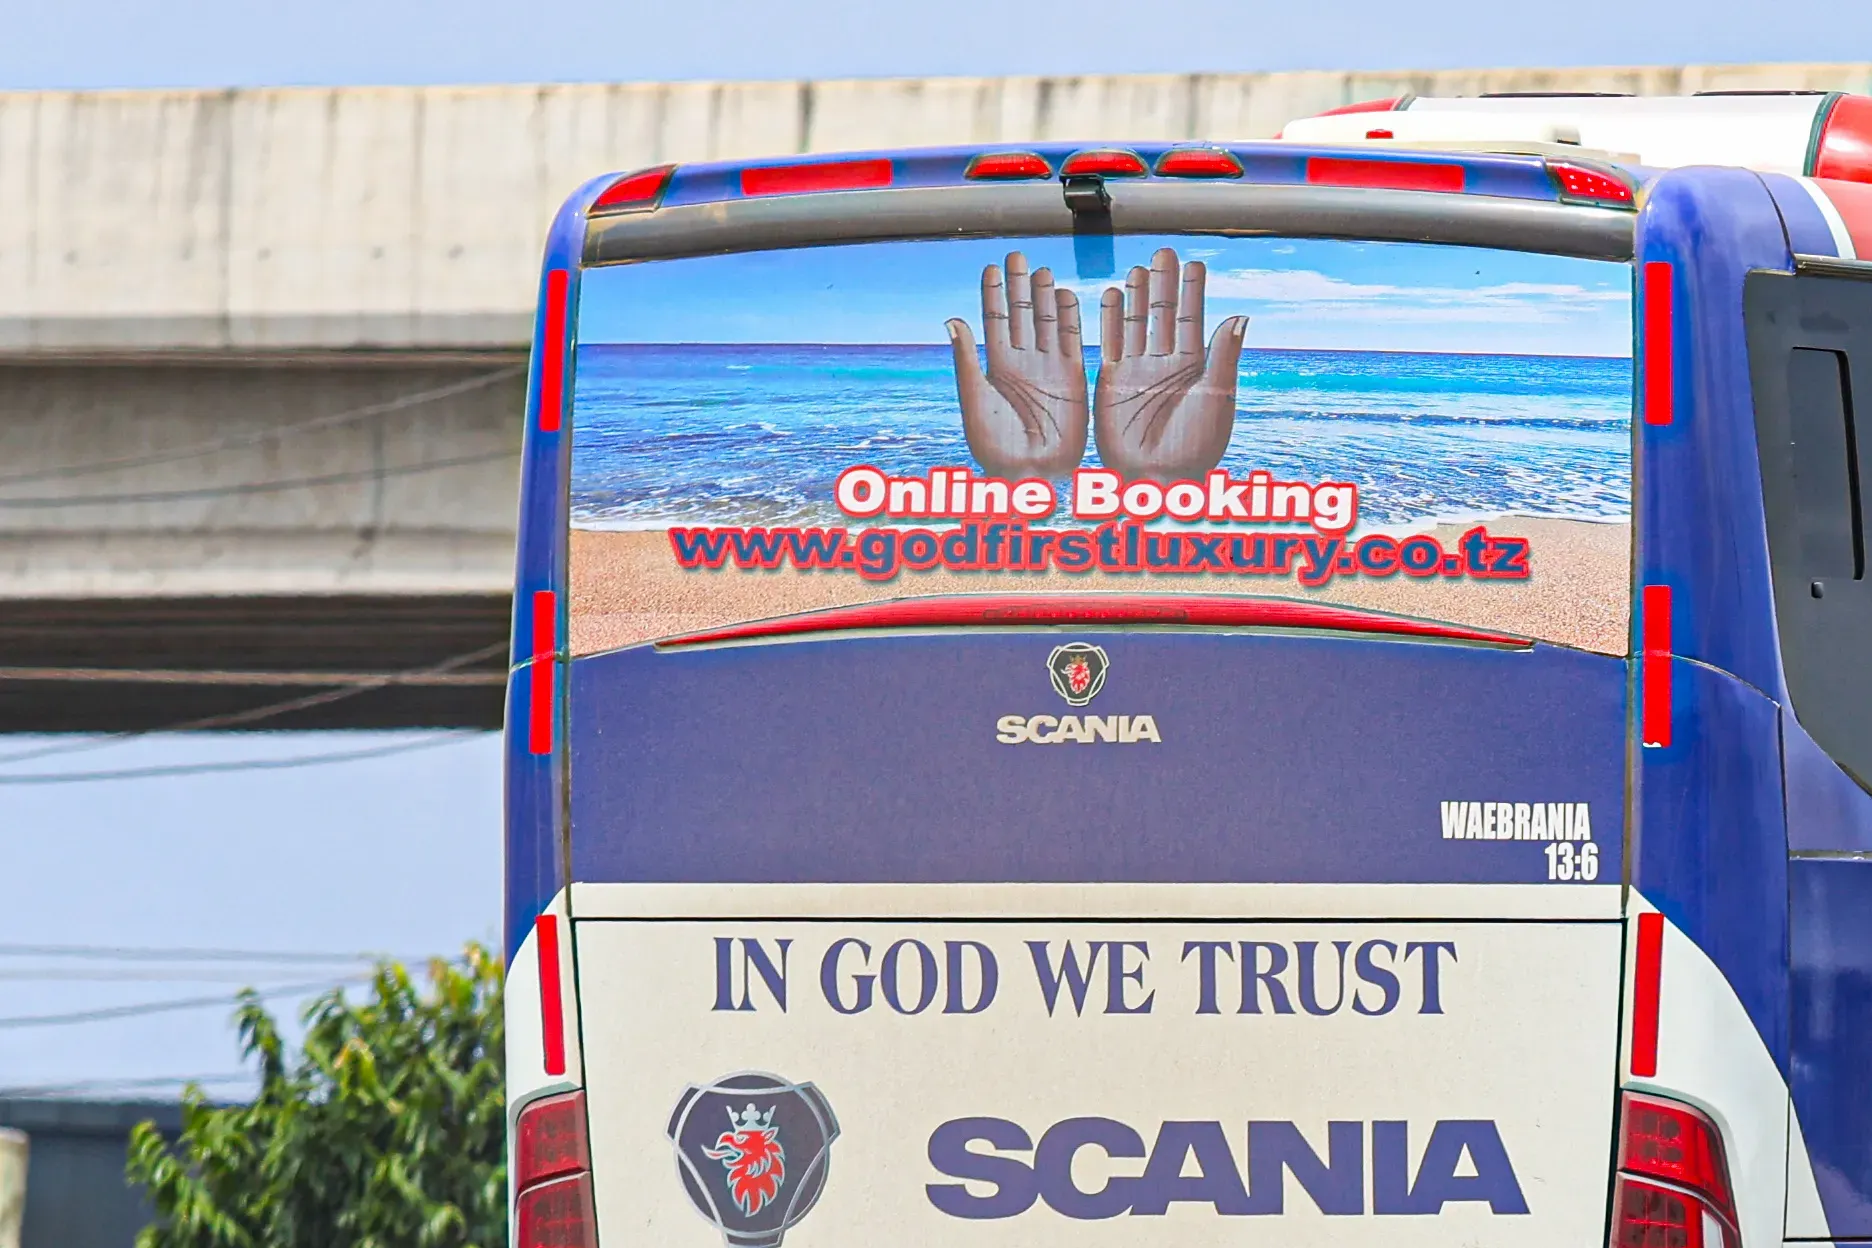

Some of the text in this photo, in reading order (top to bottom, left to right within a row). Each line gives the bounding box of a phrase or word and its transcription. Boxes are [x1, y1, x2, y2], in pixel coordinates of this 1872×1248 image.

[836, 466, 1357, 533] Online Booking
[669, 520, 1531, 585] www.godfirstluxury.co.tz
[996, 714, 1161, 745] SCANIA
[1440, 801, 1591, 840] WAEBRANIA
[1545, 842, 1598, 881] 13:6
[711, 937, 1458, 1017] IN GOD WE TRUST
[924, 1117, 1530, 1219] SCANIA
